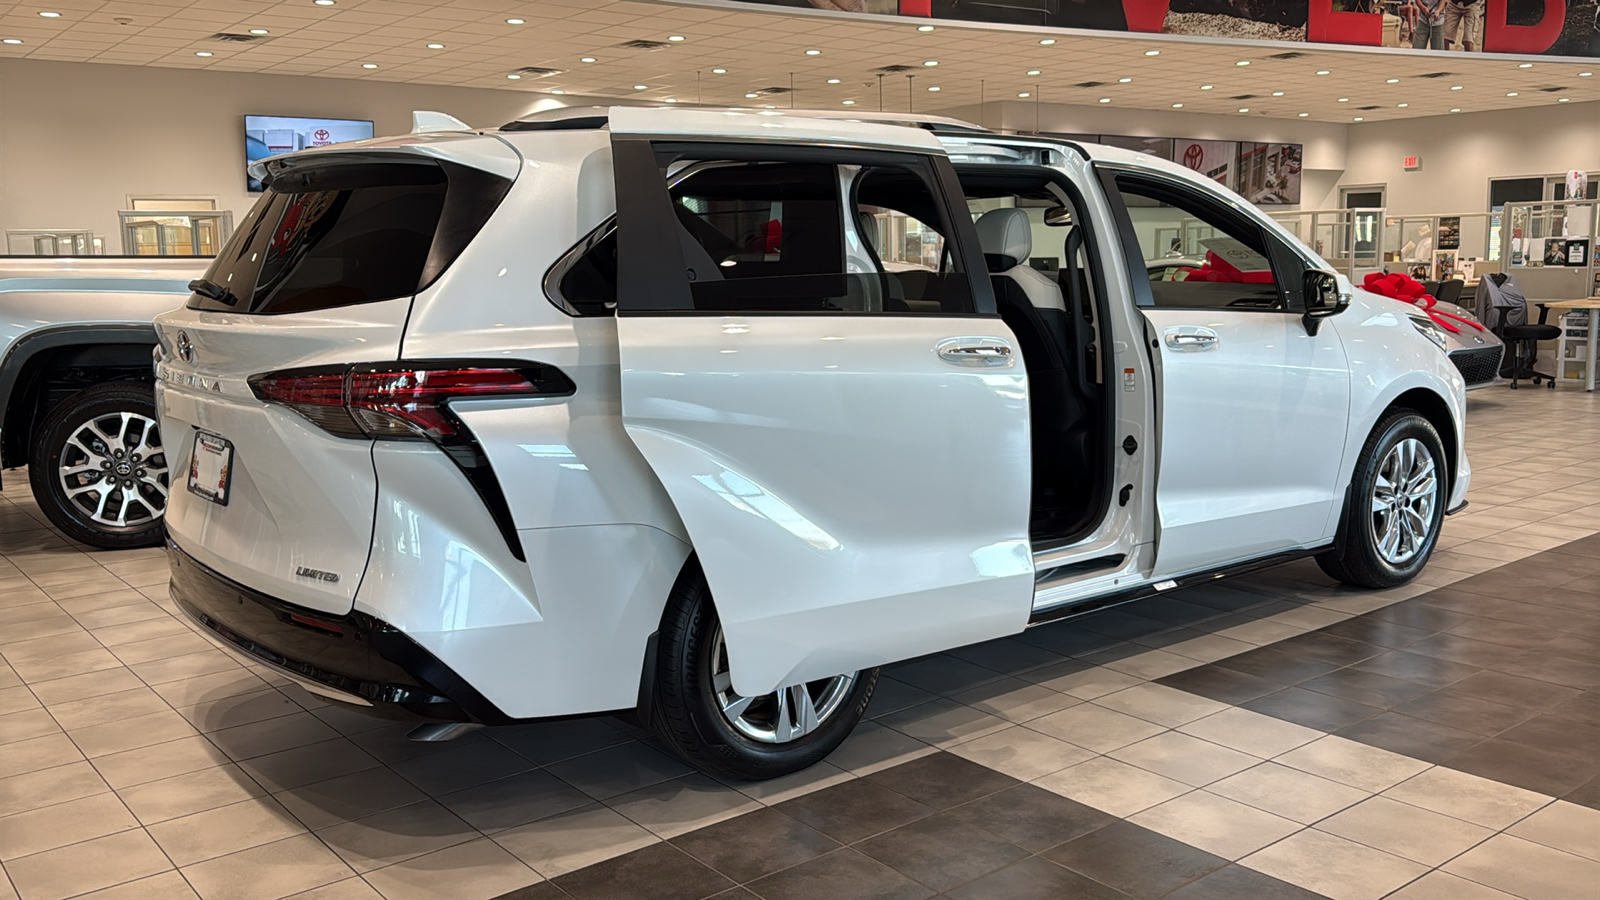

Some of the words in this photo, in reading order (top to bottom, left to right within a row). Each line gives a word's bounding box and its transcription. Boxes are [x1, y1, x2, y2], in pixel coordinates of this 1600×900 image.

[1404, 156, 1417, 167] EXIT
[163, 367, 224, 393] SIENNA
[296, 566, 341, 583] LIMITED
